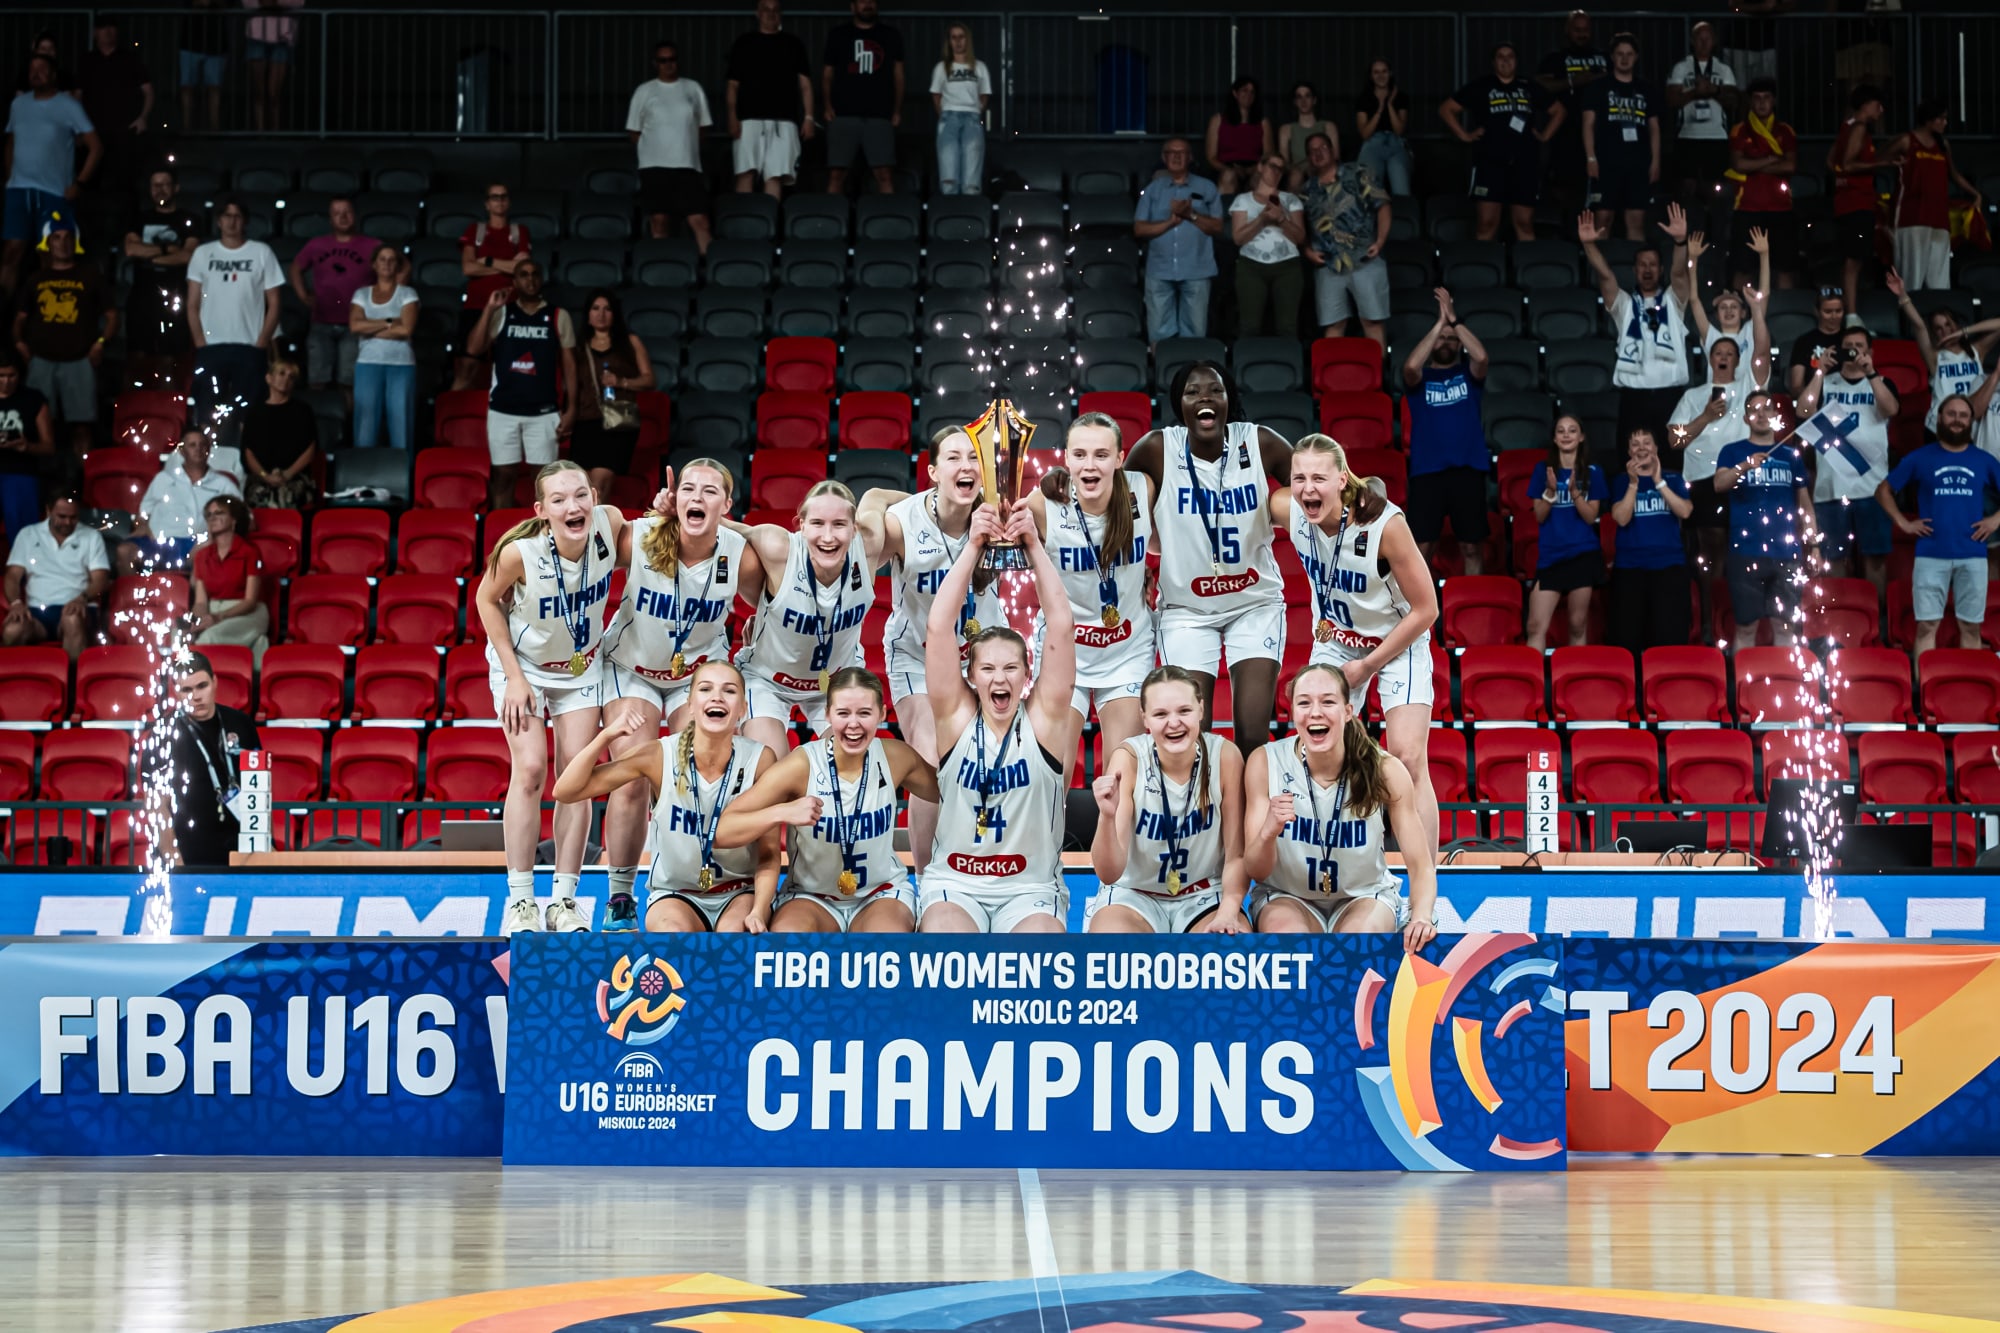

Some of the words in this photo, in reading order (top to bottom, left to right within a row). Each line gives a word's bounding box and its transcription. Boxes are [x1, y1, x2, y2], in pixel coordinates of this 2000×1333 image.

[208, 259, 253, 272] FRANCE
[507, 324, 549, 339] FRANCE
[1425, 383, 1468, 405] FINLAND
[1747, 467, 1793, 484] FNLAND
[1634, 498, 1669, 513] INLAN
[1060, 536, 1144, 573] FIND
[248, 751, 259, 769] 5
[1538, 751, 1549, 769] 5
[249, 774, 258, 789] 4
[957, 757, 1030, 794] FINAND
[1538, 775, 1547, 790] 4
[247, 794, 256, 810] 3
[1540, 795, 1549, 811] 3
[249, 815, 259, 830] 2
[1540, 816, 1549, 832] 2
[249, 836, 255, 852] 1
[1542, 837, 1548, 851] 1
[754, 951, 829, 988] FIBA
[840, 951, 900, 988] U16
[909, 952, 1075, 989] WOMEN'S
[1086, 952, 1313, 990] EUROBASKET
[972, 999, 1072, 1025] MISKOLC
[1078, 1000, 1138, 1025] 2024
[39, 994, 252, 1096] FIBA
[286, 993, 457, 1097] U16
[1566, 991, 1629, 1090] T
[1646, 990, 1902, 1096] 2024
[624, 1063, 654, 1078] FIBA
[615, 1083, 677, 1093] WOMEN'S
[747, 1037, 1315, 1135] CHAMPIONS
[559, 1081, 609, 1113] U16
[615, 1094, 717, 1112] EUROBASKET
[598, 1117, 646, 1130] MISKOLC
[647, 1117, 676, 1130] 2024
